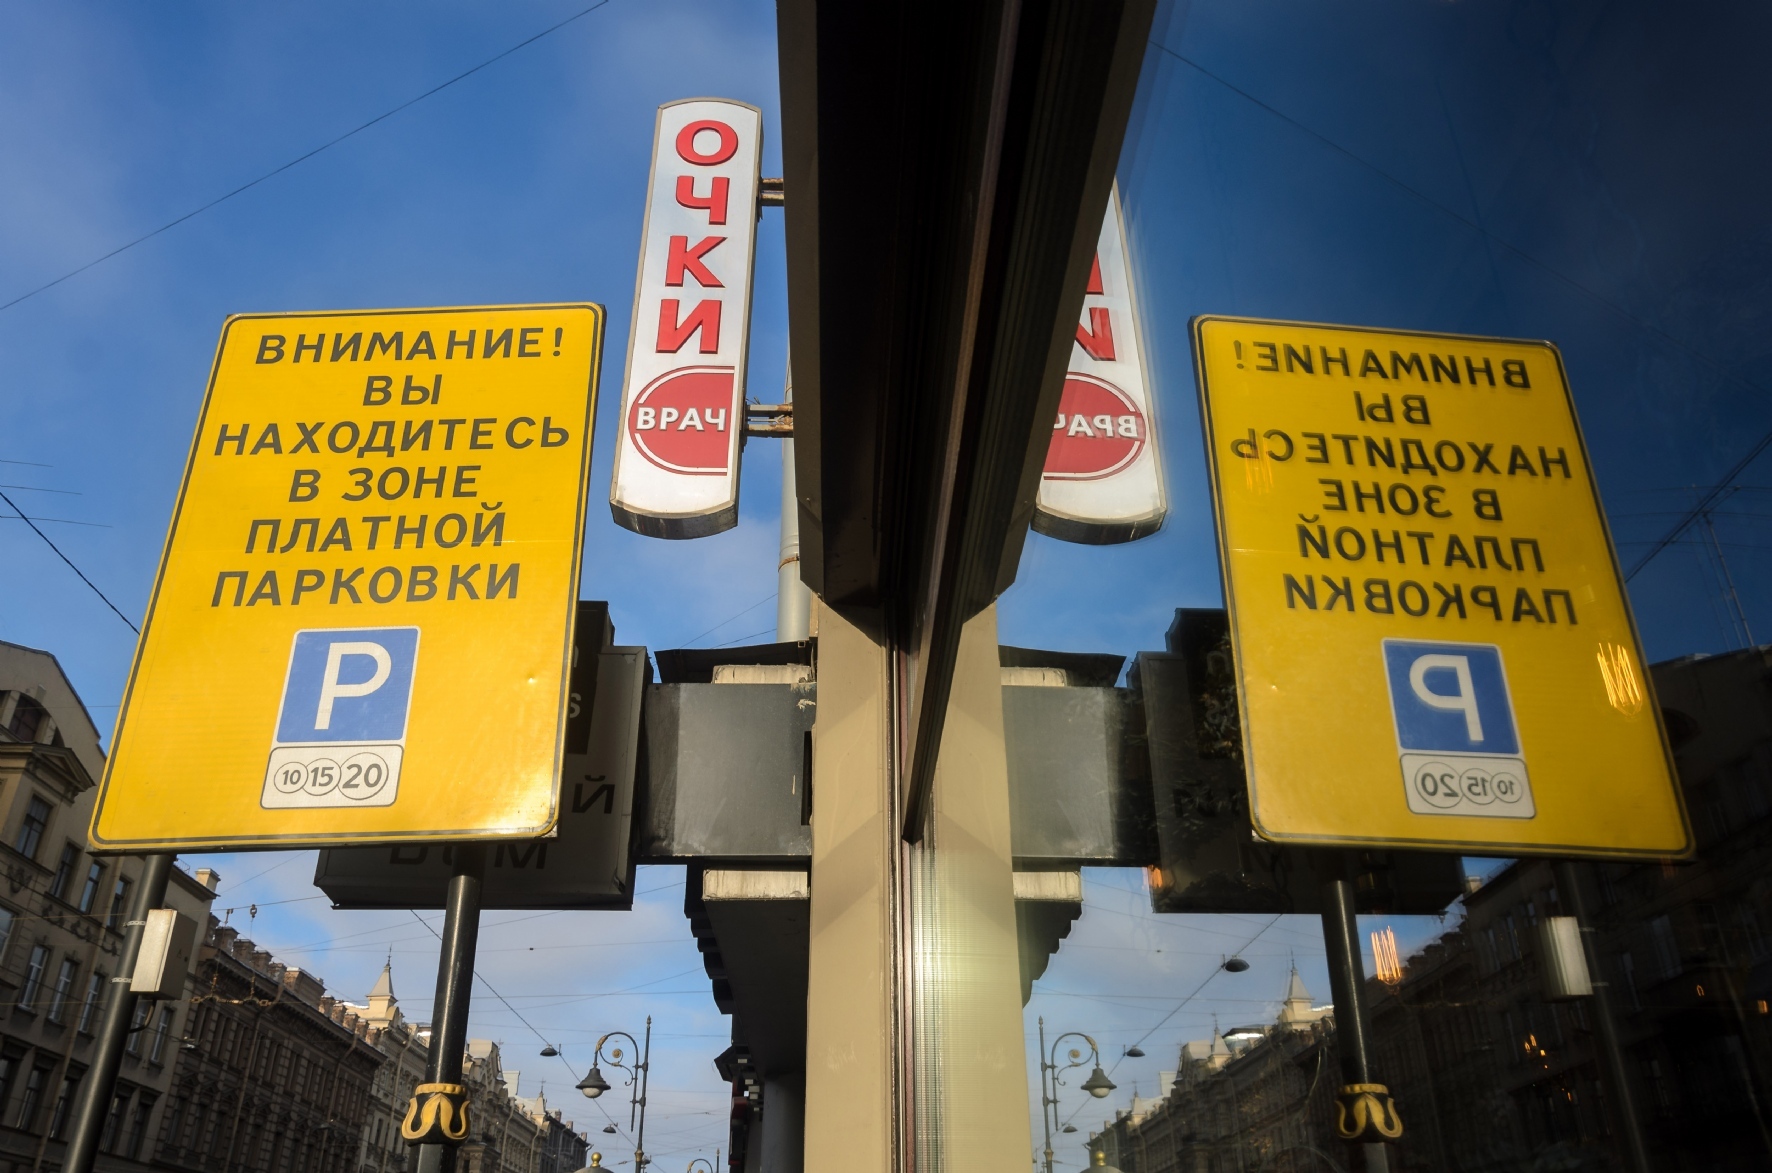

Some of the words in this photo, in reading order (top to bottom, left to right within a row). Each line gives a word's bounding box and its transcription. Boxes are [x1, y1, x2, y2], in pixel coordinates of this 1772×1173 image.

[655, 119, 739, 355] ОЧКИ
[255, 327, 565, 365] ВНИМАНИЕ!
[362, 373, 443, 407] ВЫ
[214, 416, 570, 459] НАХОДИТЕСЬ
[635, 406, 727, 432] ВРАЧ
[288, 469, 321, 503] В
[341, 464, 482, 502] ЗОНЕ
[244, 501, 506, 554] ПЛАТНОЙ
[210, 563, 521, 608] ПАРКОВКИ
[314, 641, 392, 730] P
[282, 769, 302, 786] 10
[310, 766, 335, 787] 15
[342, 763, 383, 789] 20
